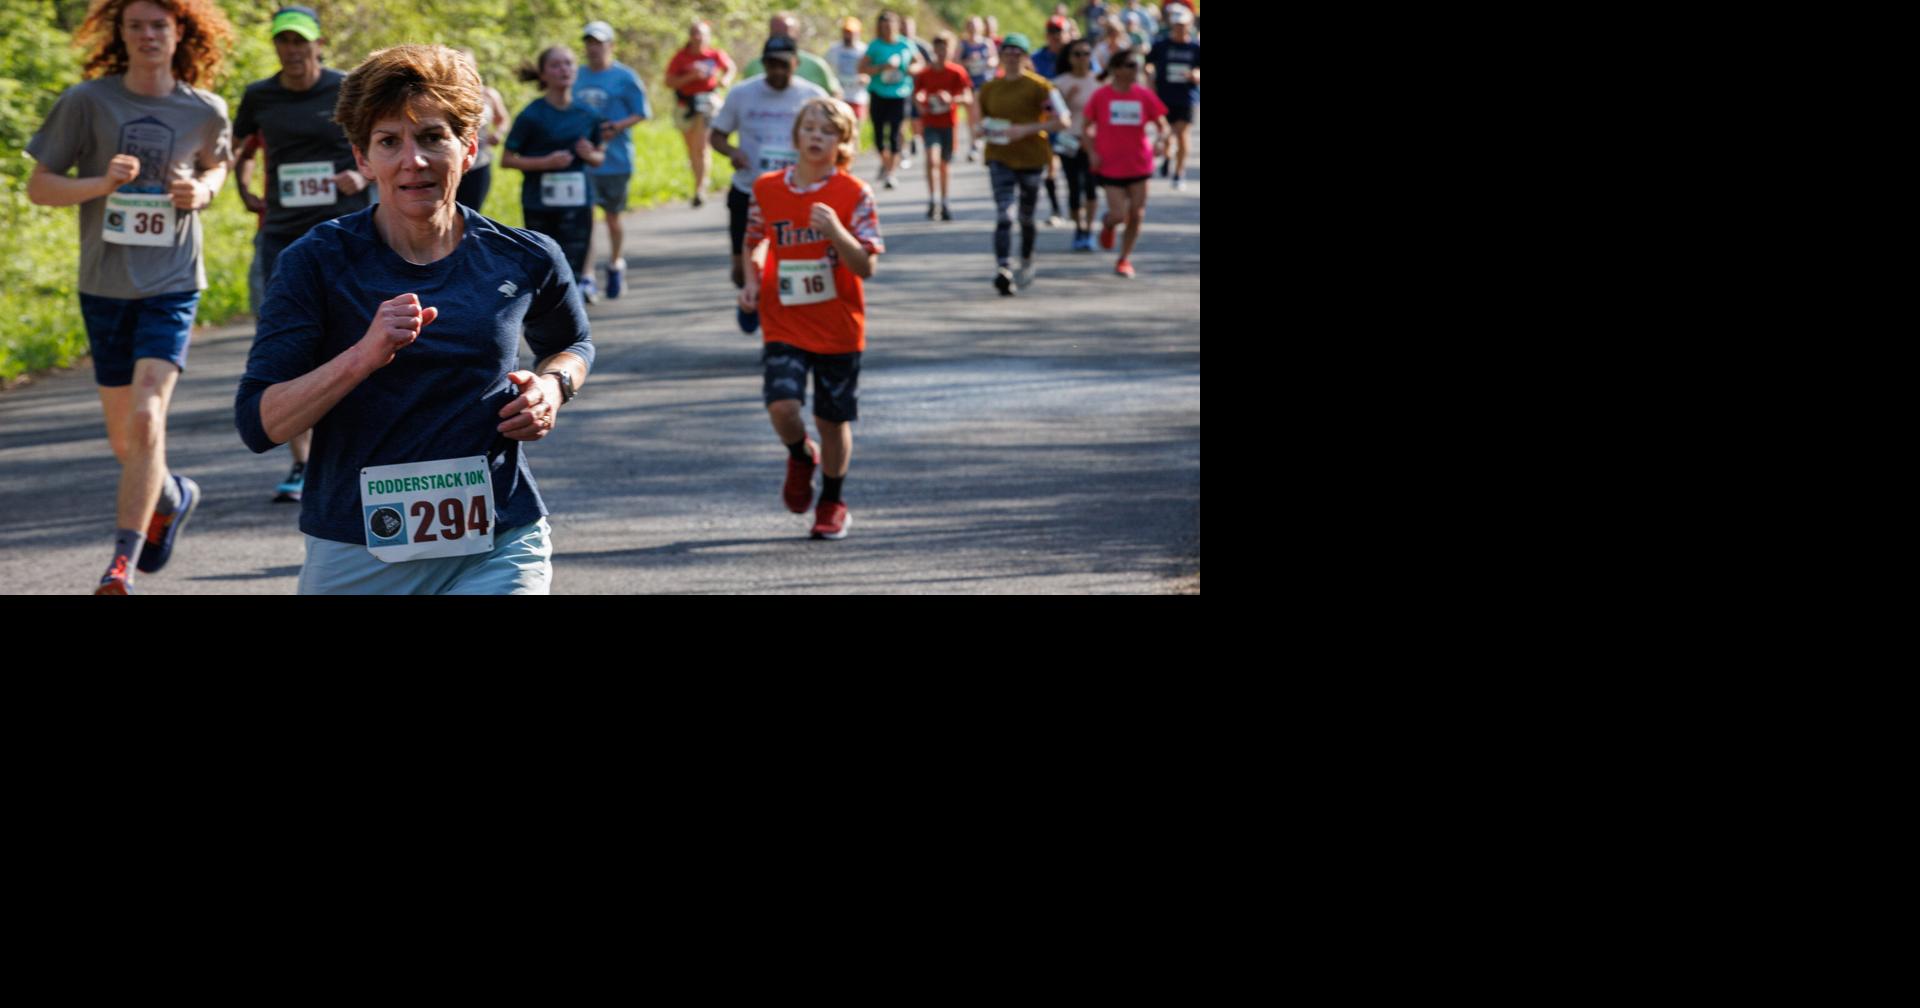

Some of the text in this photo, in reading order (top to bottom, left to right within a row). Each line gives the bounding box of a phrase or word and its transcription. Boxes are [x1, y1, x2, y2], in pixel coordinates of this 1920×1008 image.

[299, 177, 331, 196] 194
[566, 184, 574, 198] 1
[134, 212, 165, 234] 36
[803, 275, 825, 295] 16
[367, 469, 486, 496] FODDERSTACK 10K
[410, 494, 490, 543] 294
